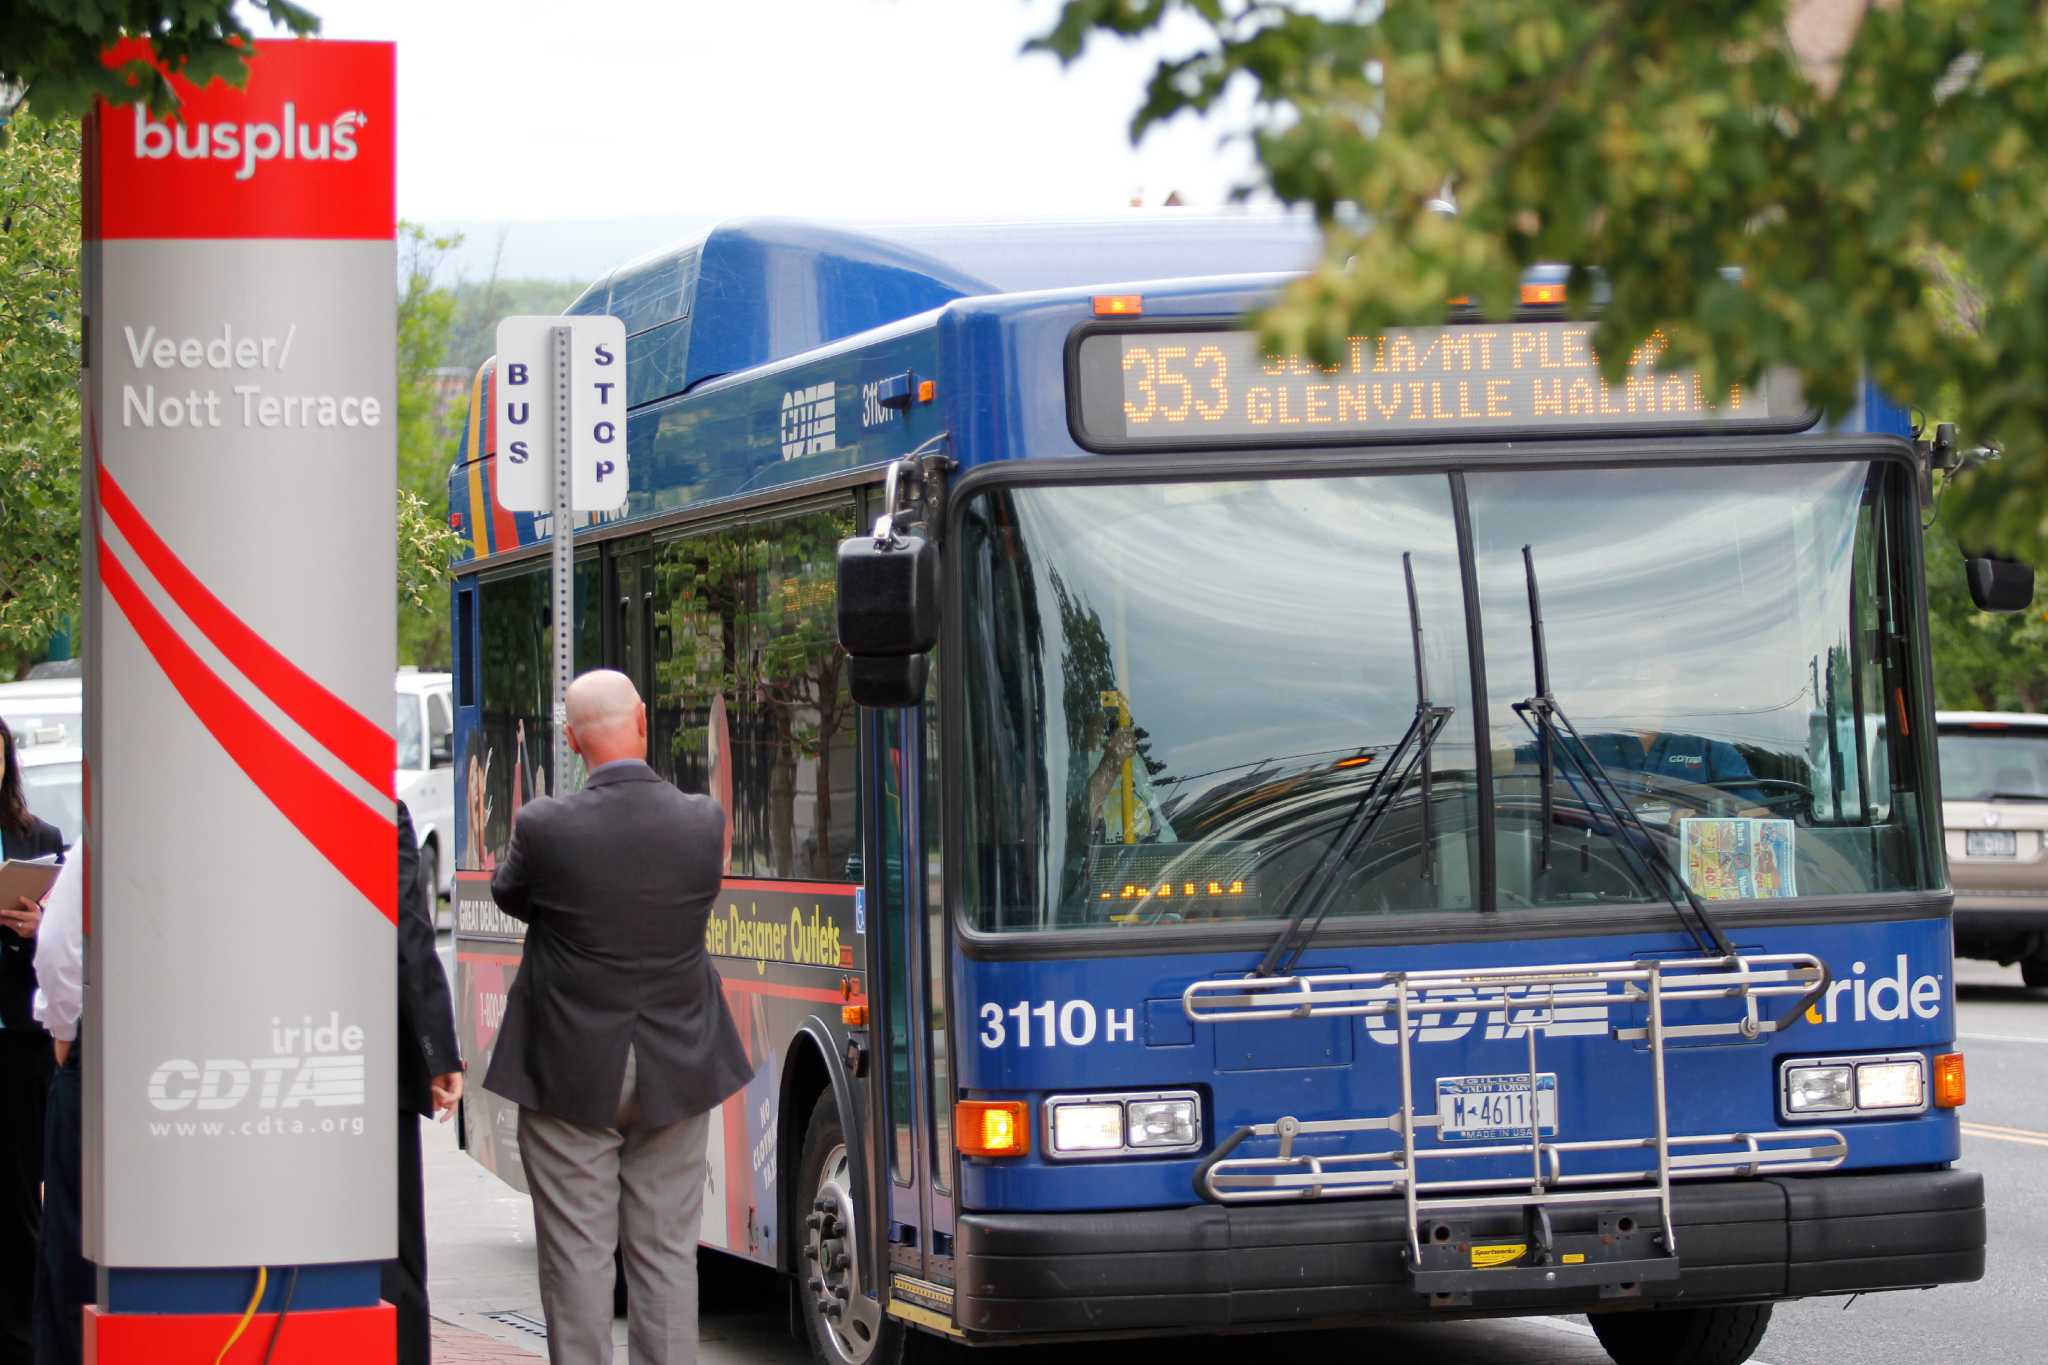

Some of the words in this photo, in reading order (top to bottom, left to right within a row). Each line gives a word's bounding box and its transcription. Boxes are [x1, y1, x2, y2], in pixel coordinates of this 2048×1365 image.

[124, 322, 297, 370] Veeder/
[122, 384, 222, 428] Nott
[234, 384, 382, 428] Terrace
[1121, 345, 1228, 424] 353
[1246, 381, 1513, 425] GLENVILLE
[507, 363, 530, 464] BUS
[593, 343, 616, 483] STOP
[459, 899, 479, 931] GREAT
[729, 901, 786, 976] Designer
[790, 903, 841, 967] Outlets
[271, 1010, 366, 1054] iride
[980, 999, 1098, 1049] 3110
[1106, 1007, 1135, 1043] H
[147, 1054, 366, 1112] CDTA
